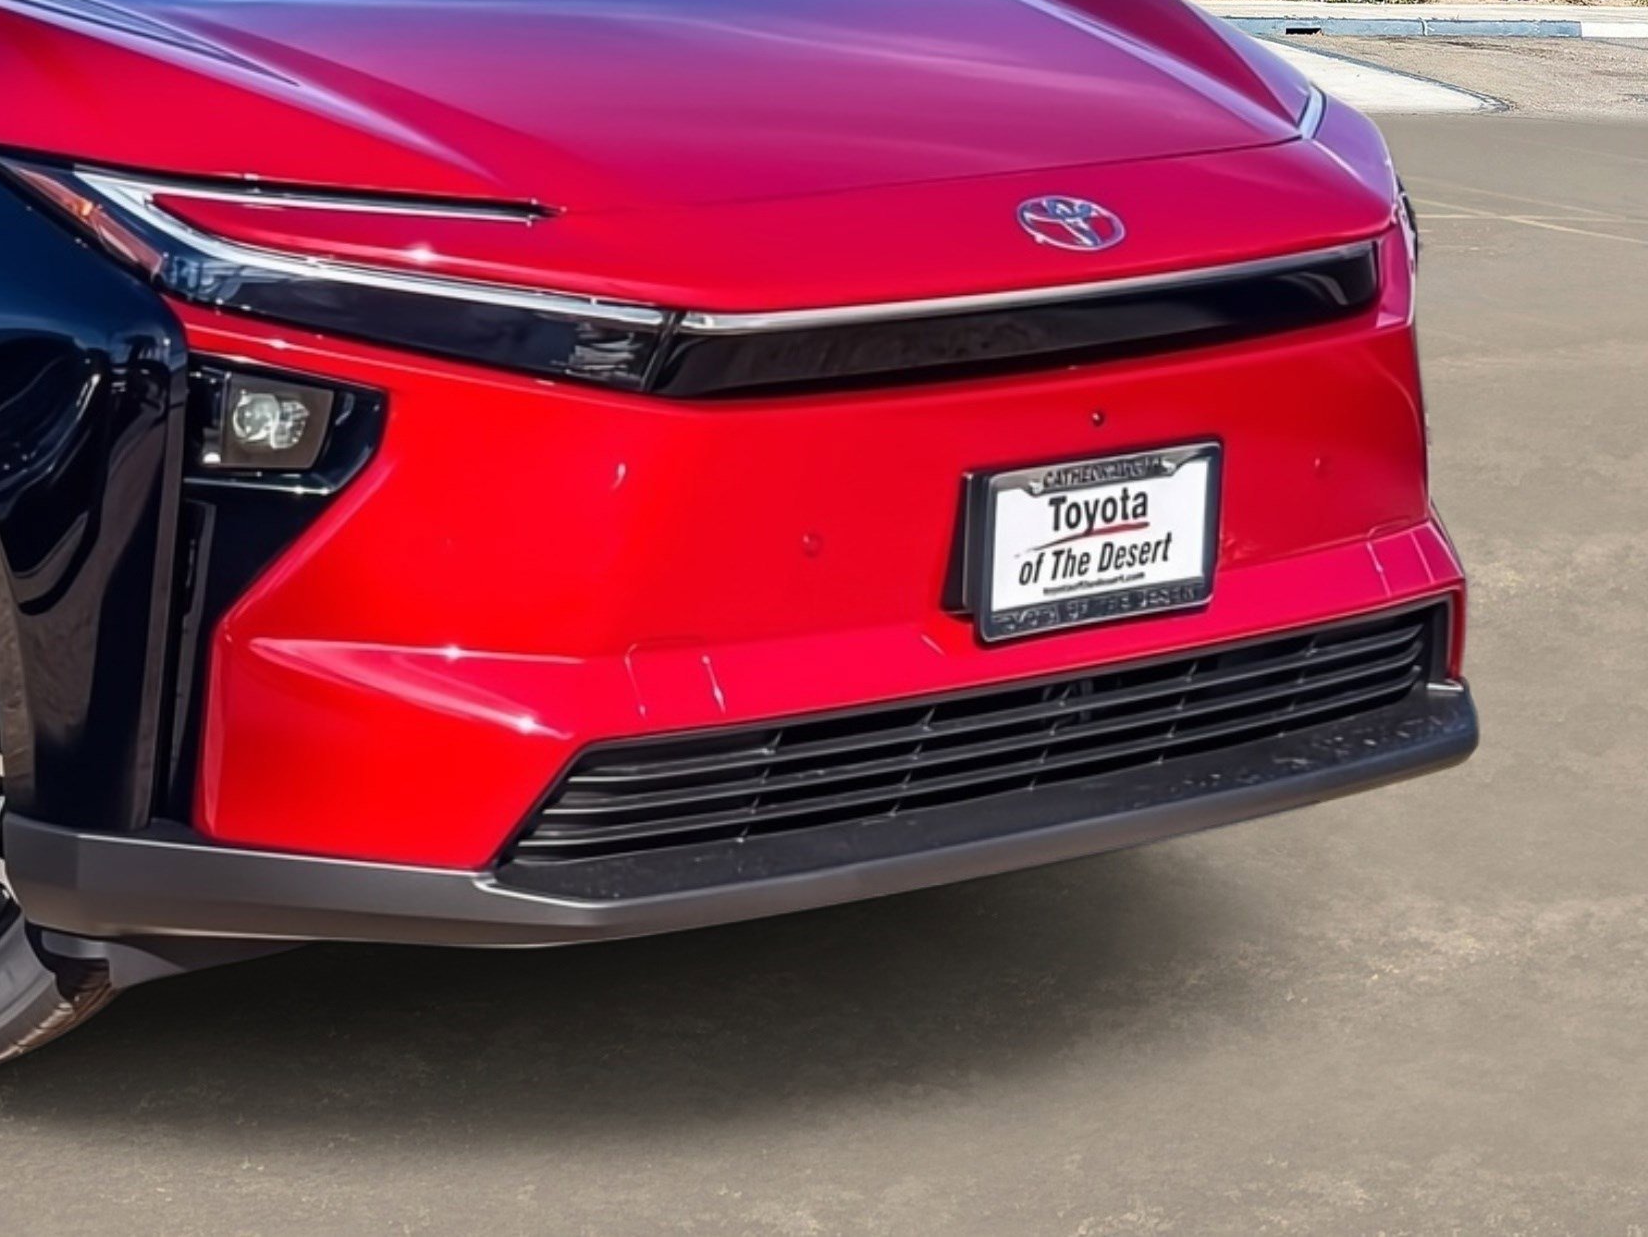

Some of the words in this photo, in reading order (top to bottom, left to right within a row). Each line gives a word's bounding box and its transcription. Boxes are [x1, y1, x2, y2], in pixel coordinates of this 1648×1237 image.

[1048, 487, 1148, 535] Toyota
[1019, 552, 1045, 585] of
[1051, 548, 1091, 580] The
[1097, 532, 1172, 573] Desert
